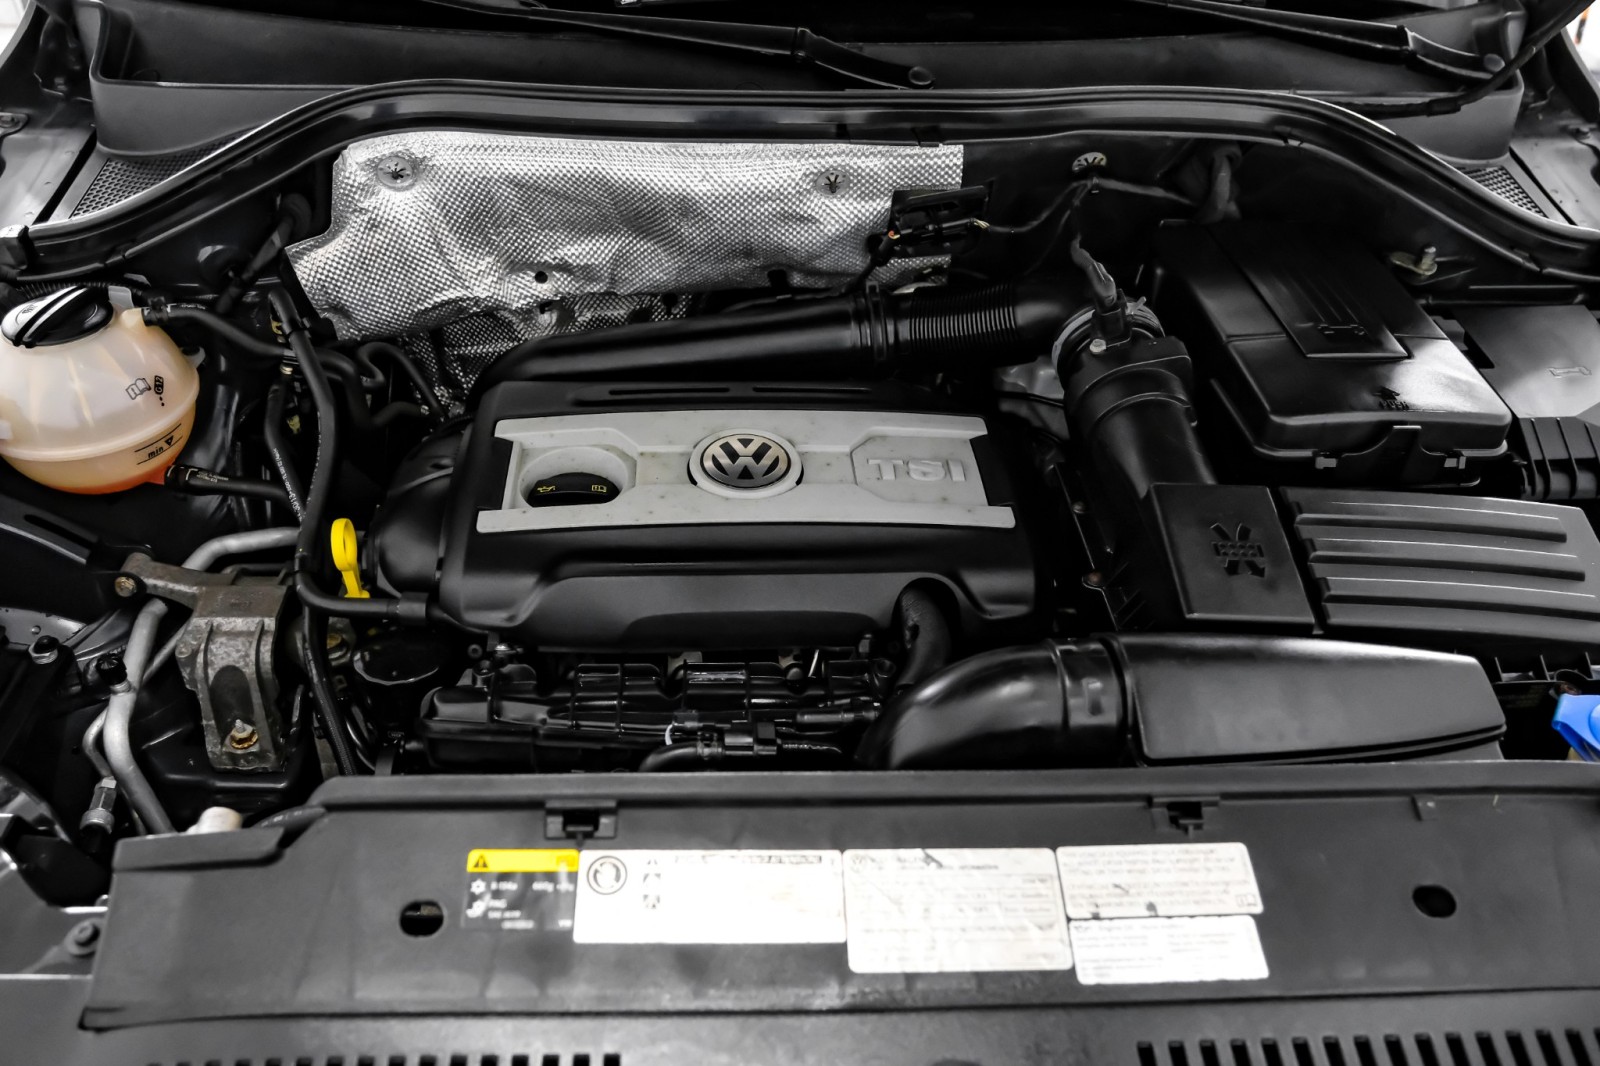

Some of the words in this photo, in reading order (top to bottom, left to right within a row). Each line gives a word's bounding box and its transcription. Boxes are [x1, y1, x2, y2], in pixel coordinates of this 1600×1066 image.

[155, 376, 164, 394] G12
[148, 447, 164, 459] min
[867, 459, 966, 481] TSI
